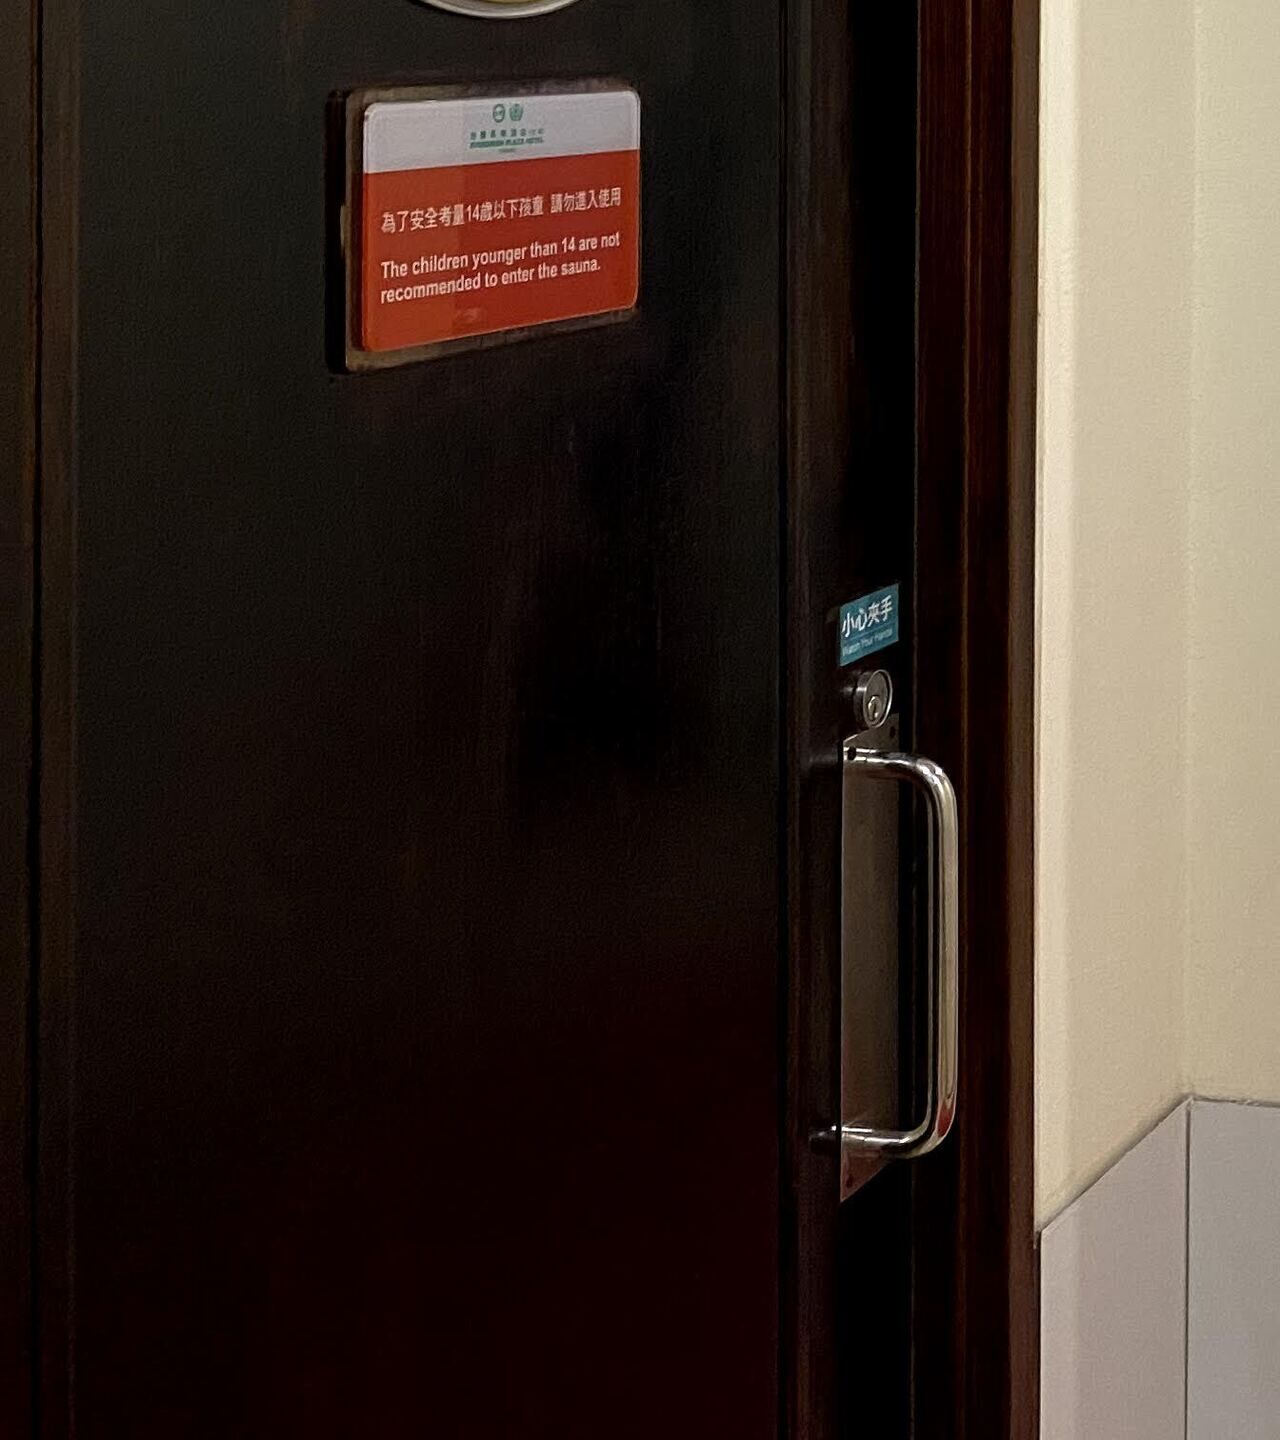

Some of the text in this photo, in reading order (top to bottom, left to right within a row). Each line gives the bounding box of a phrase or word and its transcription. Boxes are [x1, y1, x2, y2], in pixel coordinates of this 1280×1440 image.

[381, 232, 620, 279] The children younger than 14 are not
[381, 259, 601, 304] recommended to enter the sauna.
